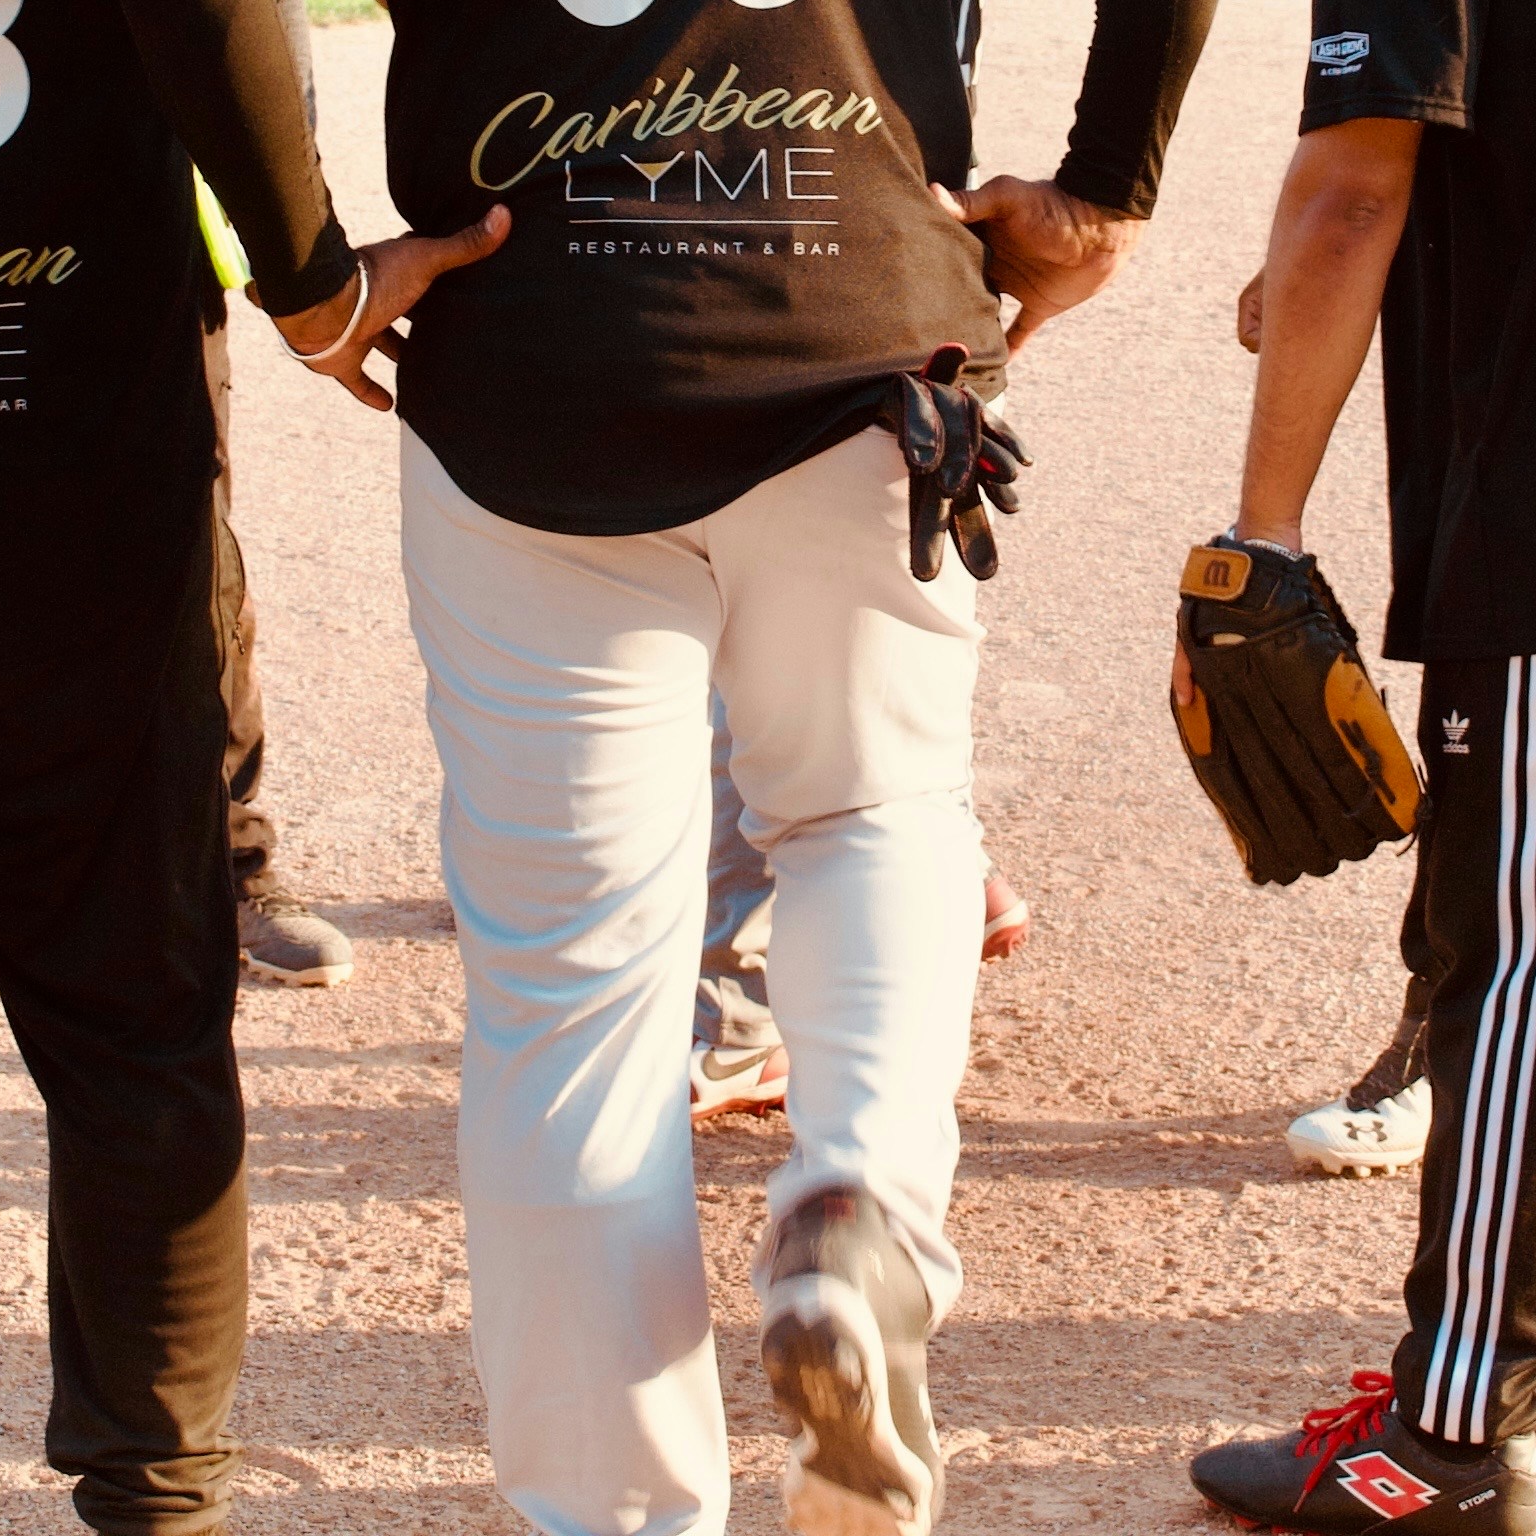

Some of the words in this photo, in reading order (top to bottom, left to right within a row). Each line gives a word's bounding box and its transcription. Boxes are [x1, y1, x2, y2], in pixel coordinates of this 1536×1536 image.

[469, 62, 883, 192] Caribbean
[565, 147, 839, 203] LYME
[568, 241, 745, 256] RESTAURANT
[763, 241, 776, 256] &
[793, 241, 841, 257] BAR
